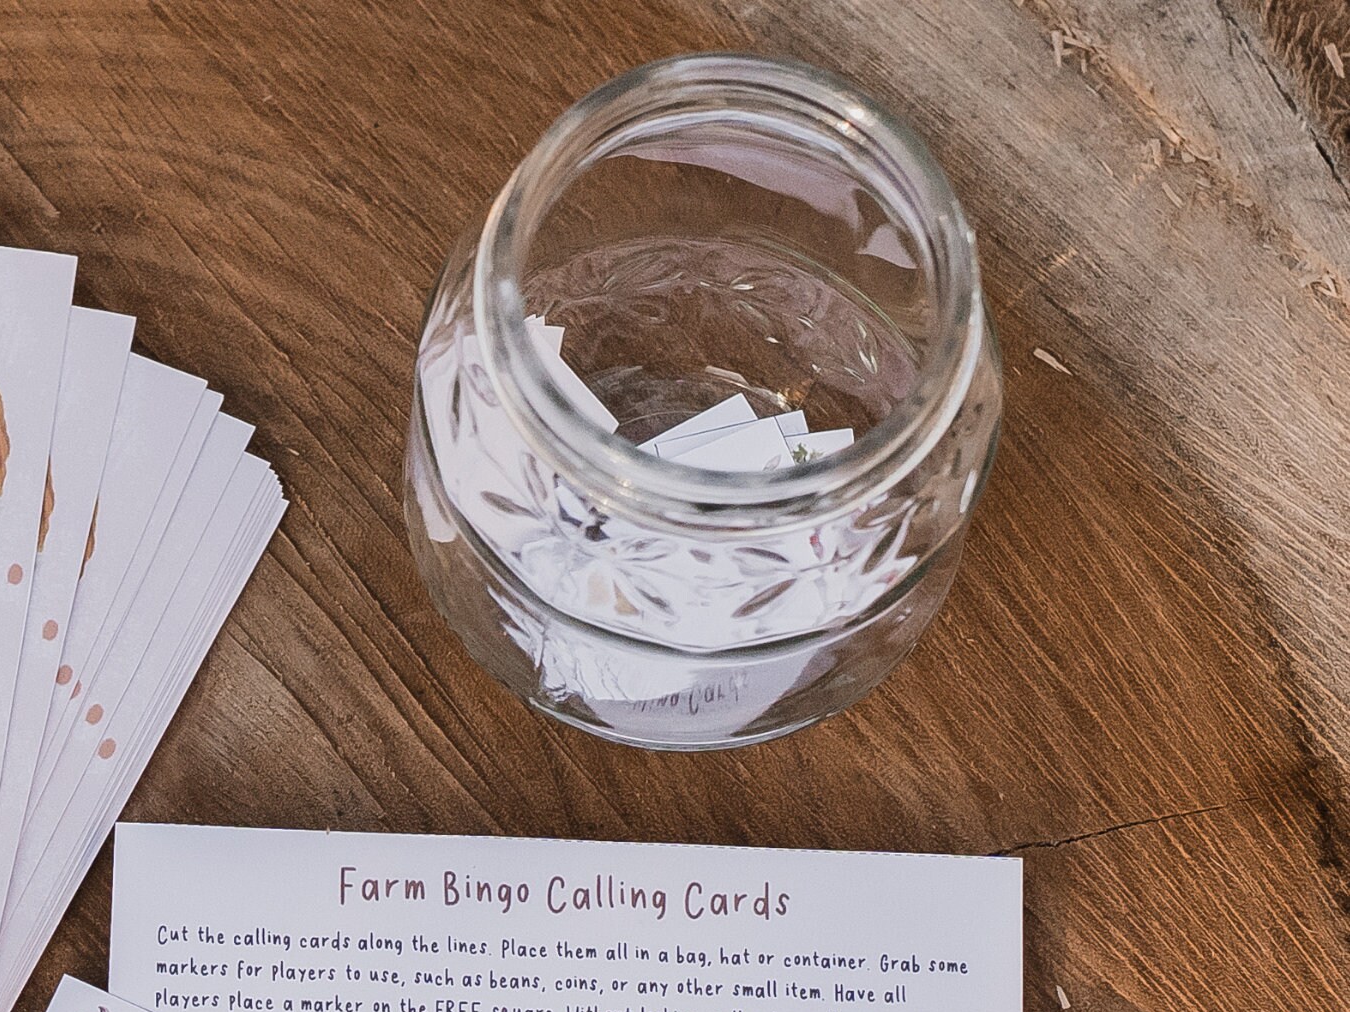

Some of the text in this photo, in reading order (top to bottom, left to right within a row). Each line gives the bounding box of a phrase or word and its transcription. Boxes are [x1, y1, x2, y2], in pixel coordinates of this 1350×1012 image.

[341, 867, 790, 920] Farm Bingo Calling Cards
[158, 925, 968, 974] Cut the calling cards along the lines. Place them all in a bag, hat or container. Grab some
[155, 988, 219, 1009] players
[229, 991, 274, 1011] place
[283, 1000, 293, 1011] a
[301, 994, 363, 1012] marker
[373, 1002, 390, 1012] on
[157, 957, 906, 1003] markers for players to use, such as beans, coins, or any other small item. Have all
